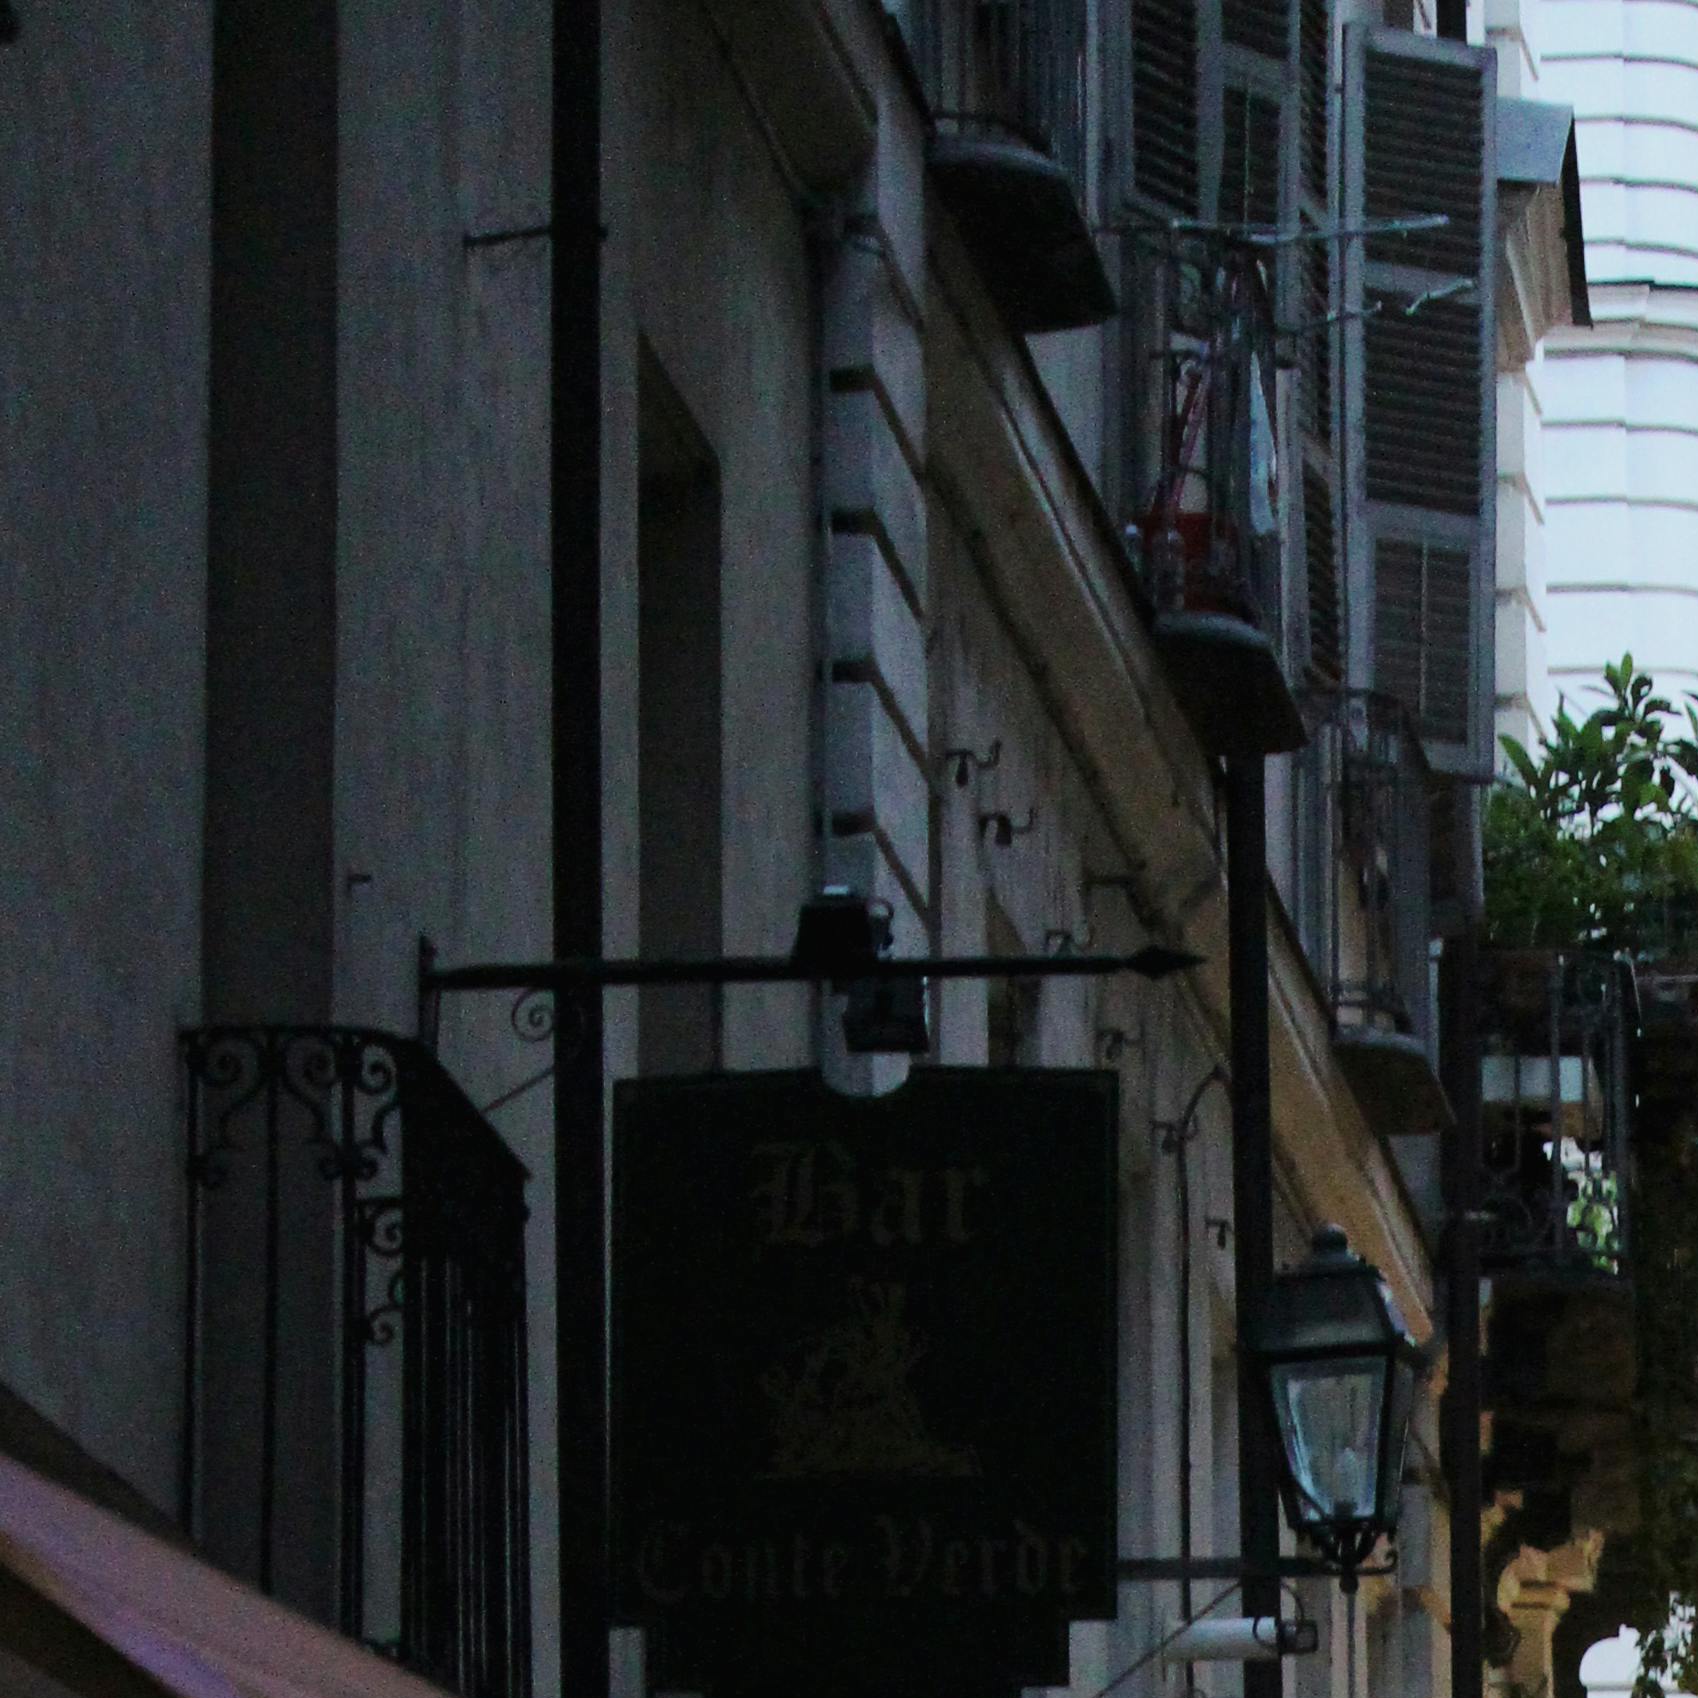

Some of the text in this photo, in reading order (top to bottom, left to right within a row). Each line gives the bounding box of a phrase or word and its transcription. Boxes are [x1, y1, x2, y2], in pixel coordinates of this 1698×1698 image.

[751, 1138, 990, 1250] Bar
[637, 1513, 1090, 1605] Conte Verde
